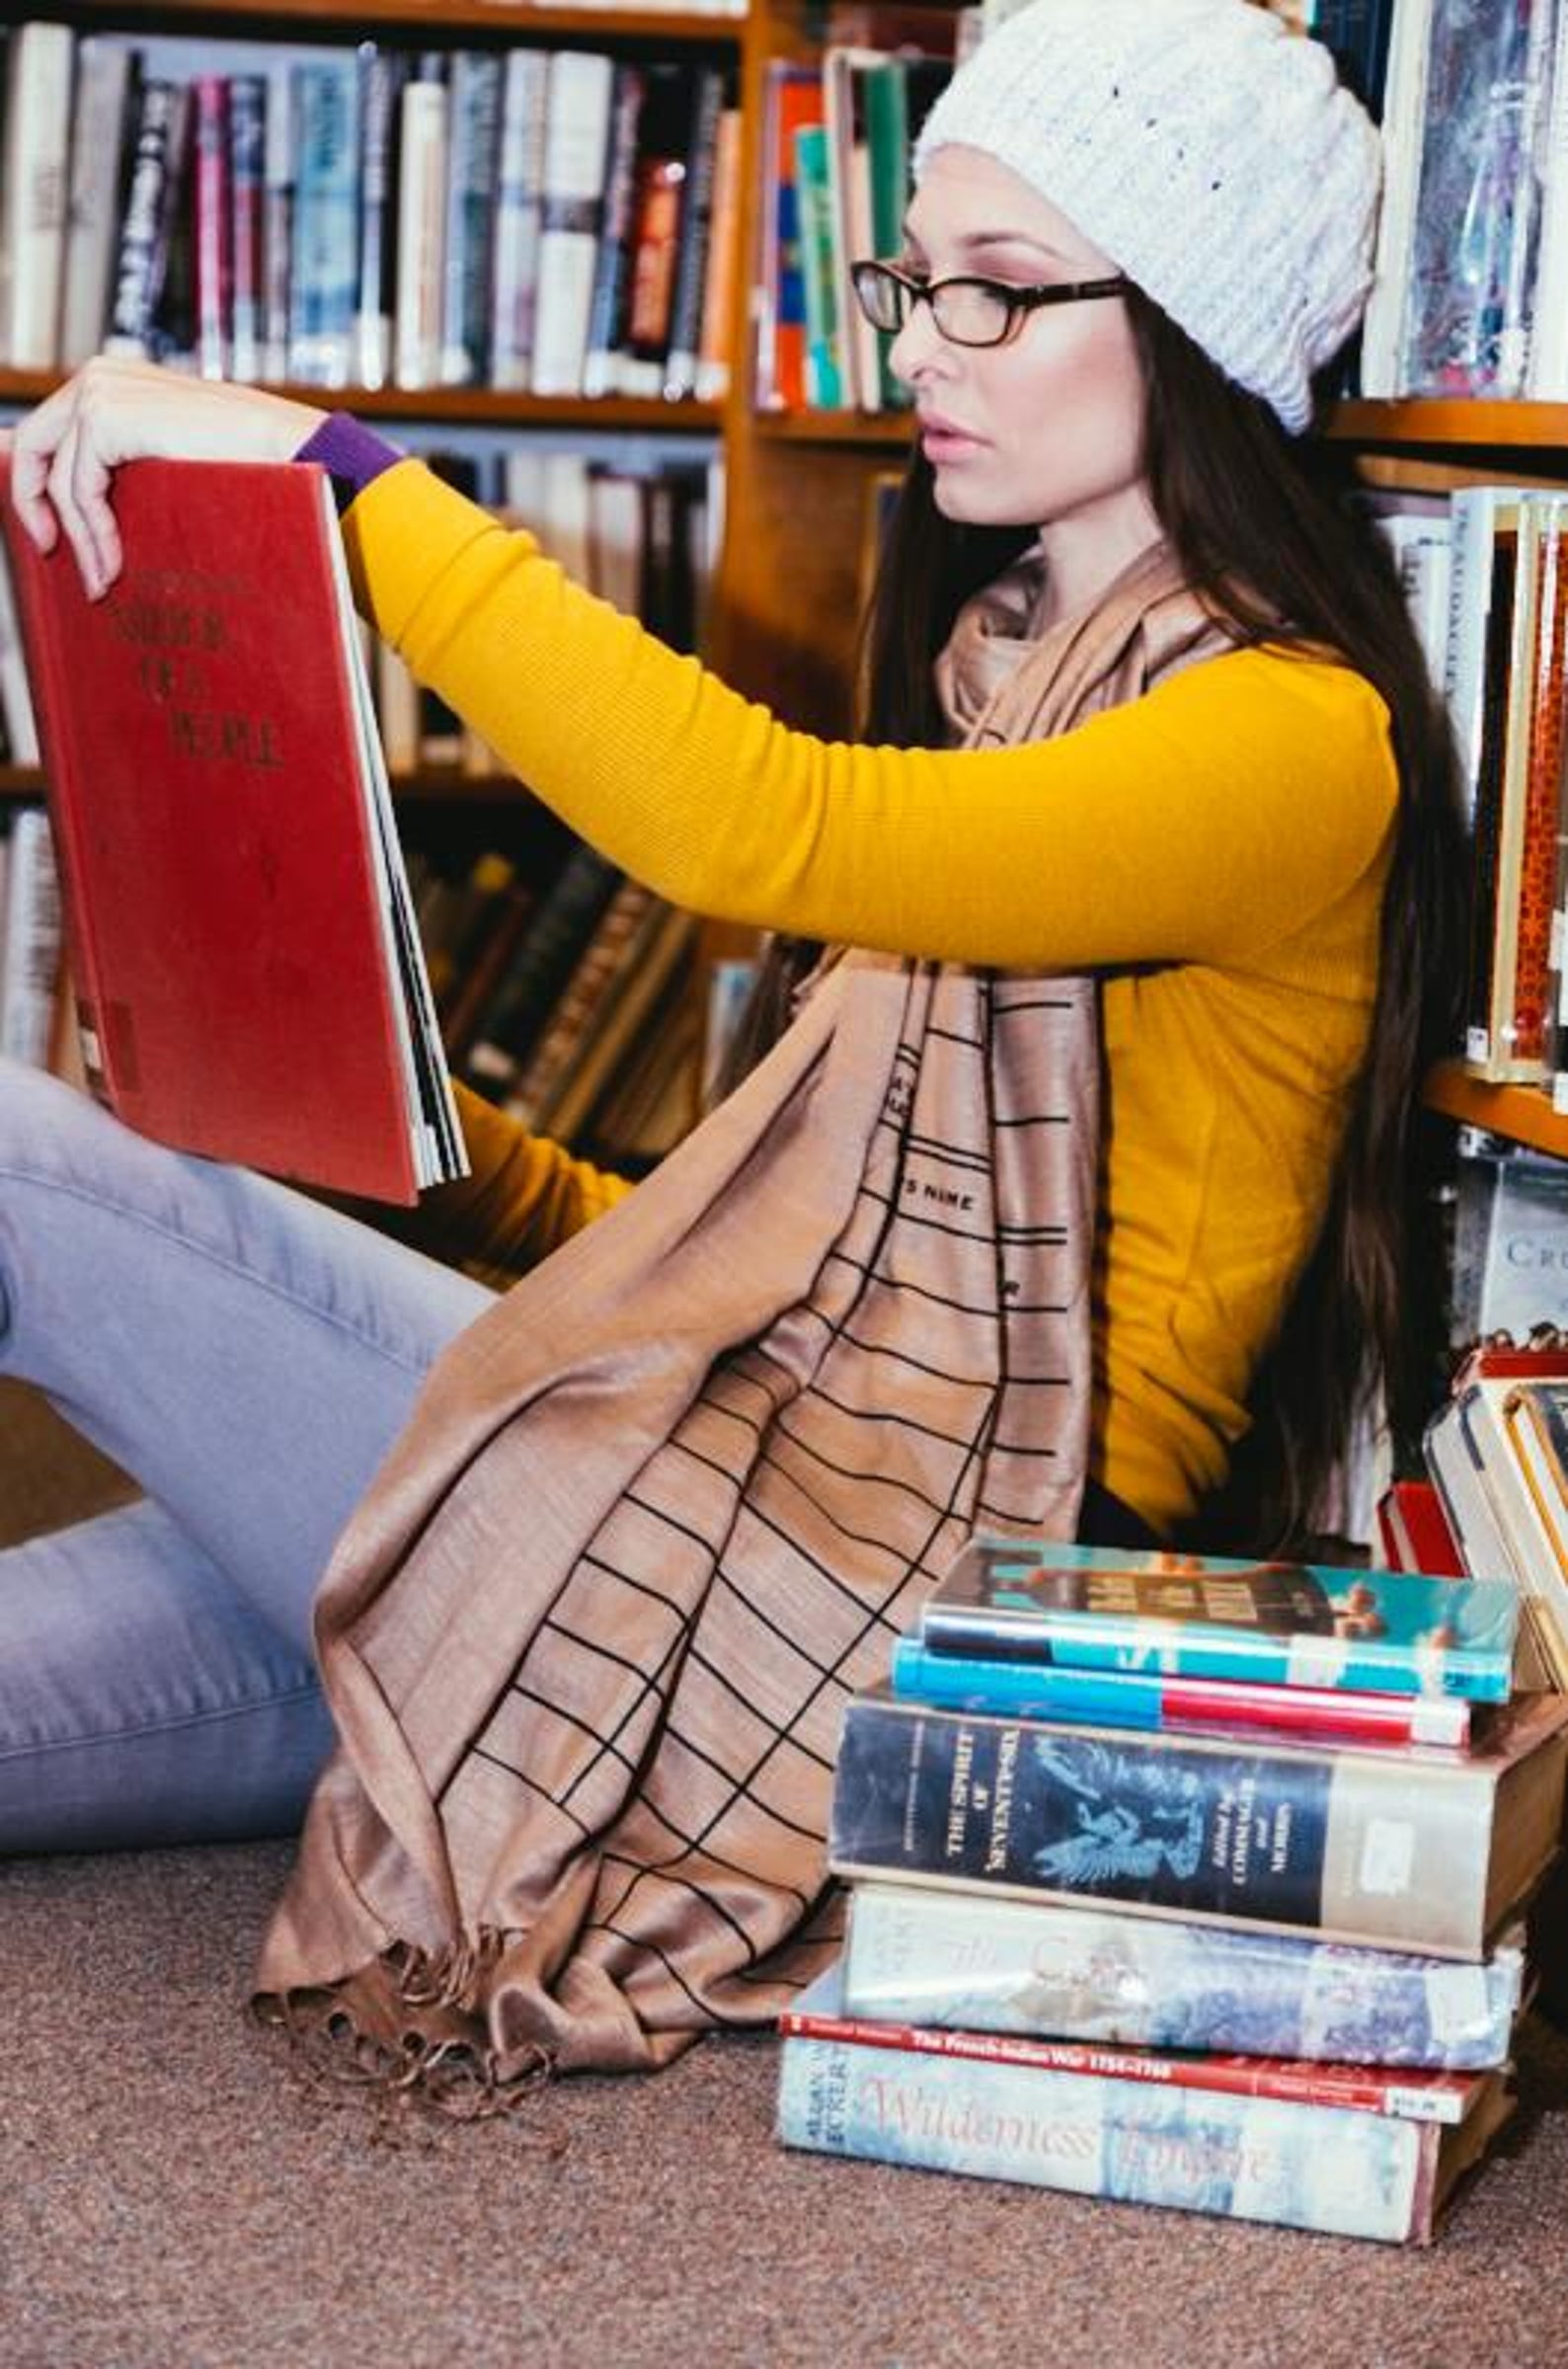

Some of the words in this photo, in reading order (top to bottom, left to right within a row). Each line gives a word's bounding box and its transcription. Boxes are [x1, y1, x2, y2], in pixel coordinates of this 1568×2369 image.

[950, 1731, 975, 1807] SPIRIT
[972, 1781, 988, 1811] OF
[946, 1809, 967, 1857] THE
[910, 2029, 941, 2051] The
[1052, 2047, 1086, 2070] War
[858, 2077, 1098, 2161] Wilderness
